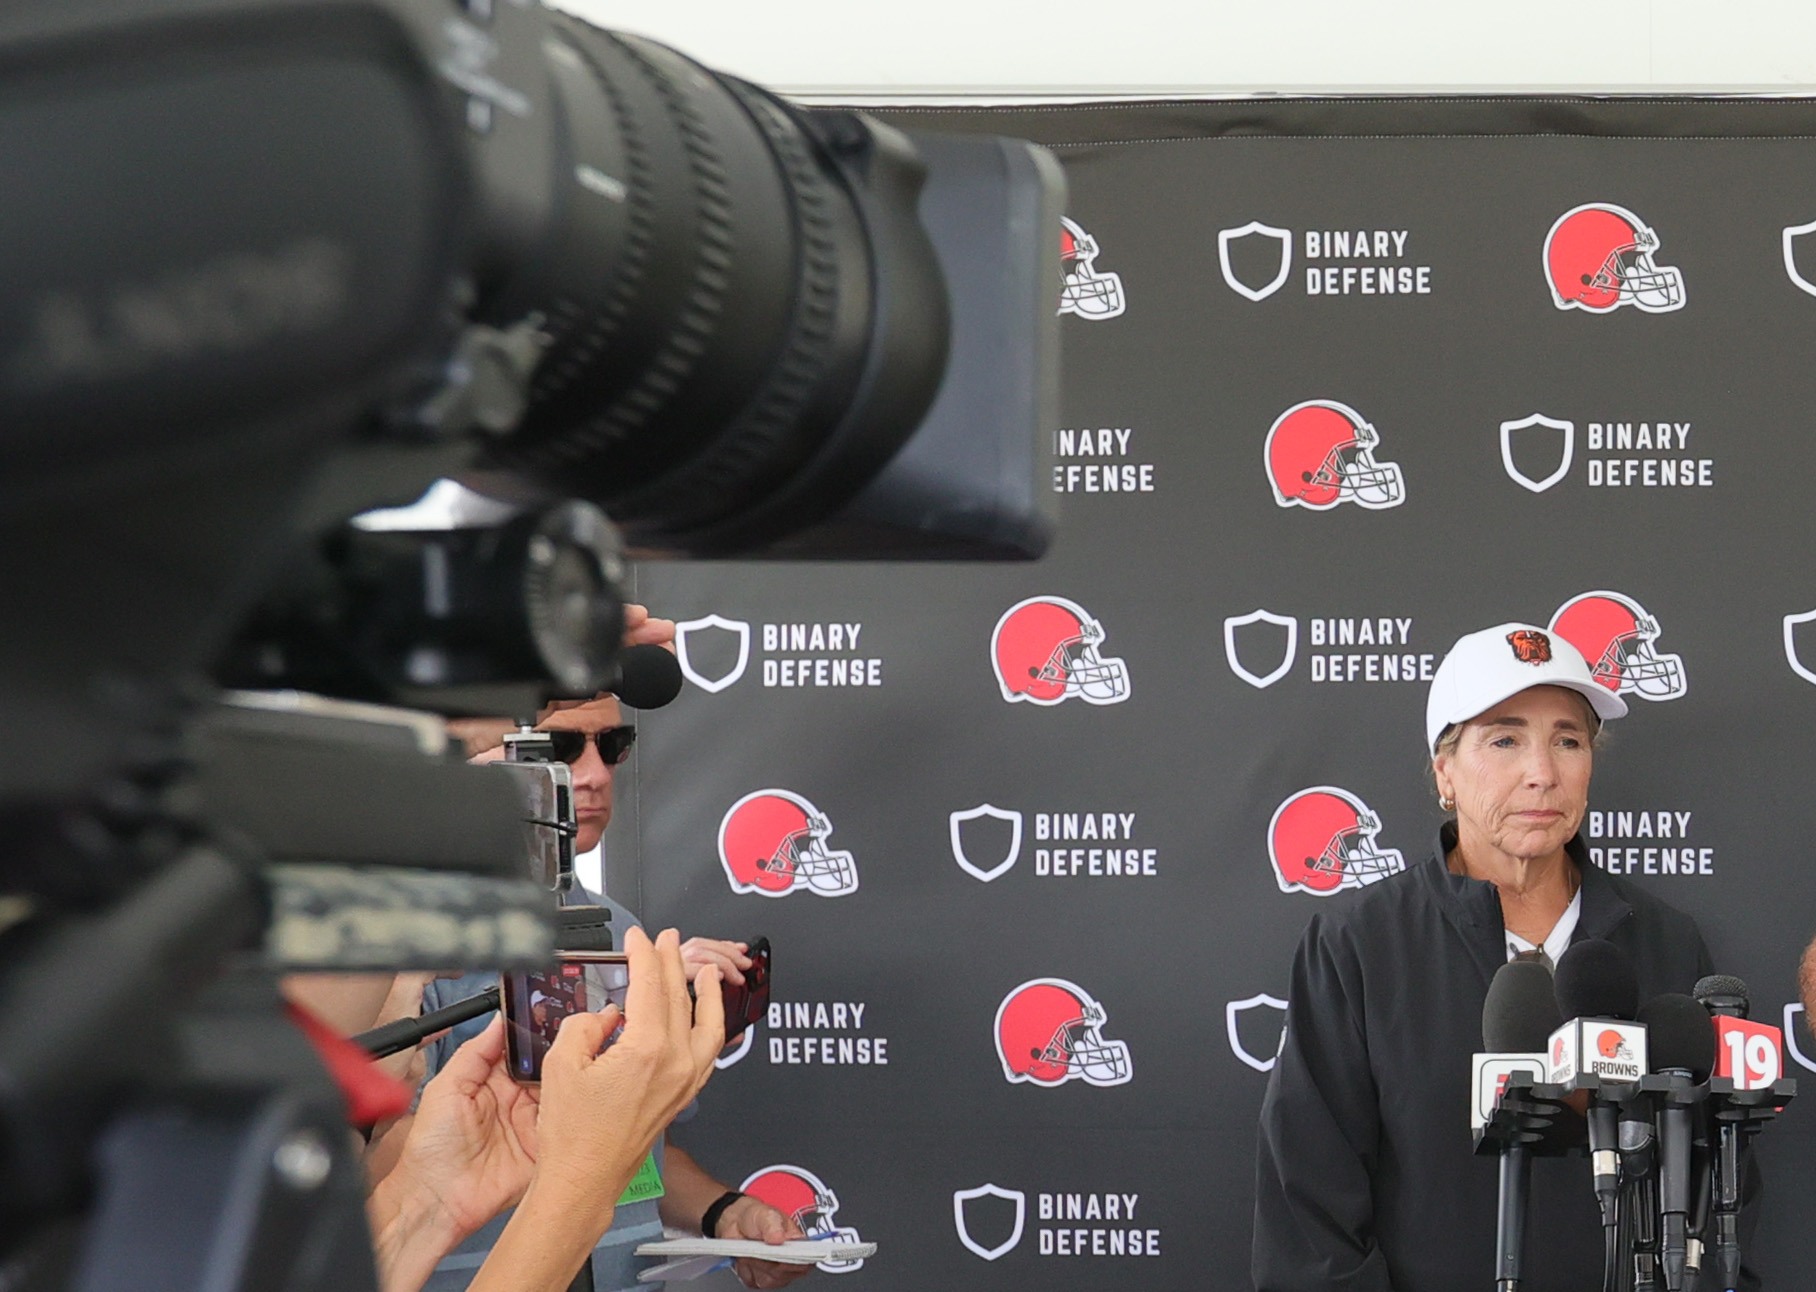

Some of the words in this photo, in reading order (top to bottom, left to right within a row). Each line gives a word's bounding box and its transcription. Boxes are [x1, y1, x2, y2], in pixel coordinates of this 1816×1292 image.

[1305, 230, 1408, 258] BINARY
[1306, 266, 1431, 295] DEFENSE
[1057, 428, 1131, 456] NARY
[1588, 423, 1691, 450] BINARY
[1054, 464, 1154, 493] EFENSE
[1588, 459, 1713, 486] DEFENSE
[763, 623, 861, 651] BINARY
[1311, 618, 1412, 646] BINARY
[763, 659, 882, 687] DEFENSE
[1311, 653, 1434, 683] DEFENSE
[1035, 813, 1135, 840] BINARY
[1589, 811, 1692, 838] BINARY
[1035, 849, 1157, 876] DEFENSE
[767, 1002, 865, 1029] BINARY
[769, 1037, 888, 1065] DEFENSE
[1723, 1030, 1779, 1091] 19
[1592, 1060, 1639, 1077] BROWNS
[1039, 1193, 1138, 1220] BINARY
[1039, 1229, 1160, 1256] DEFENSE
